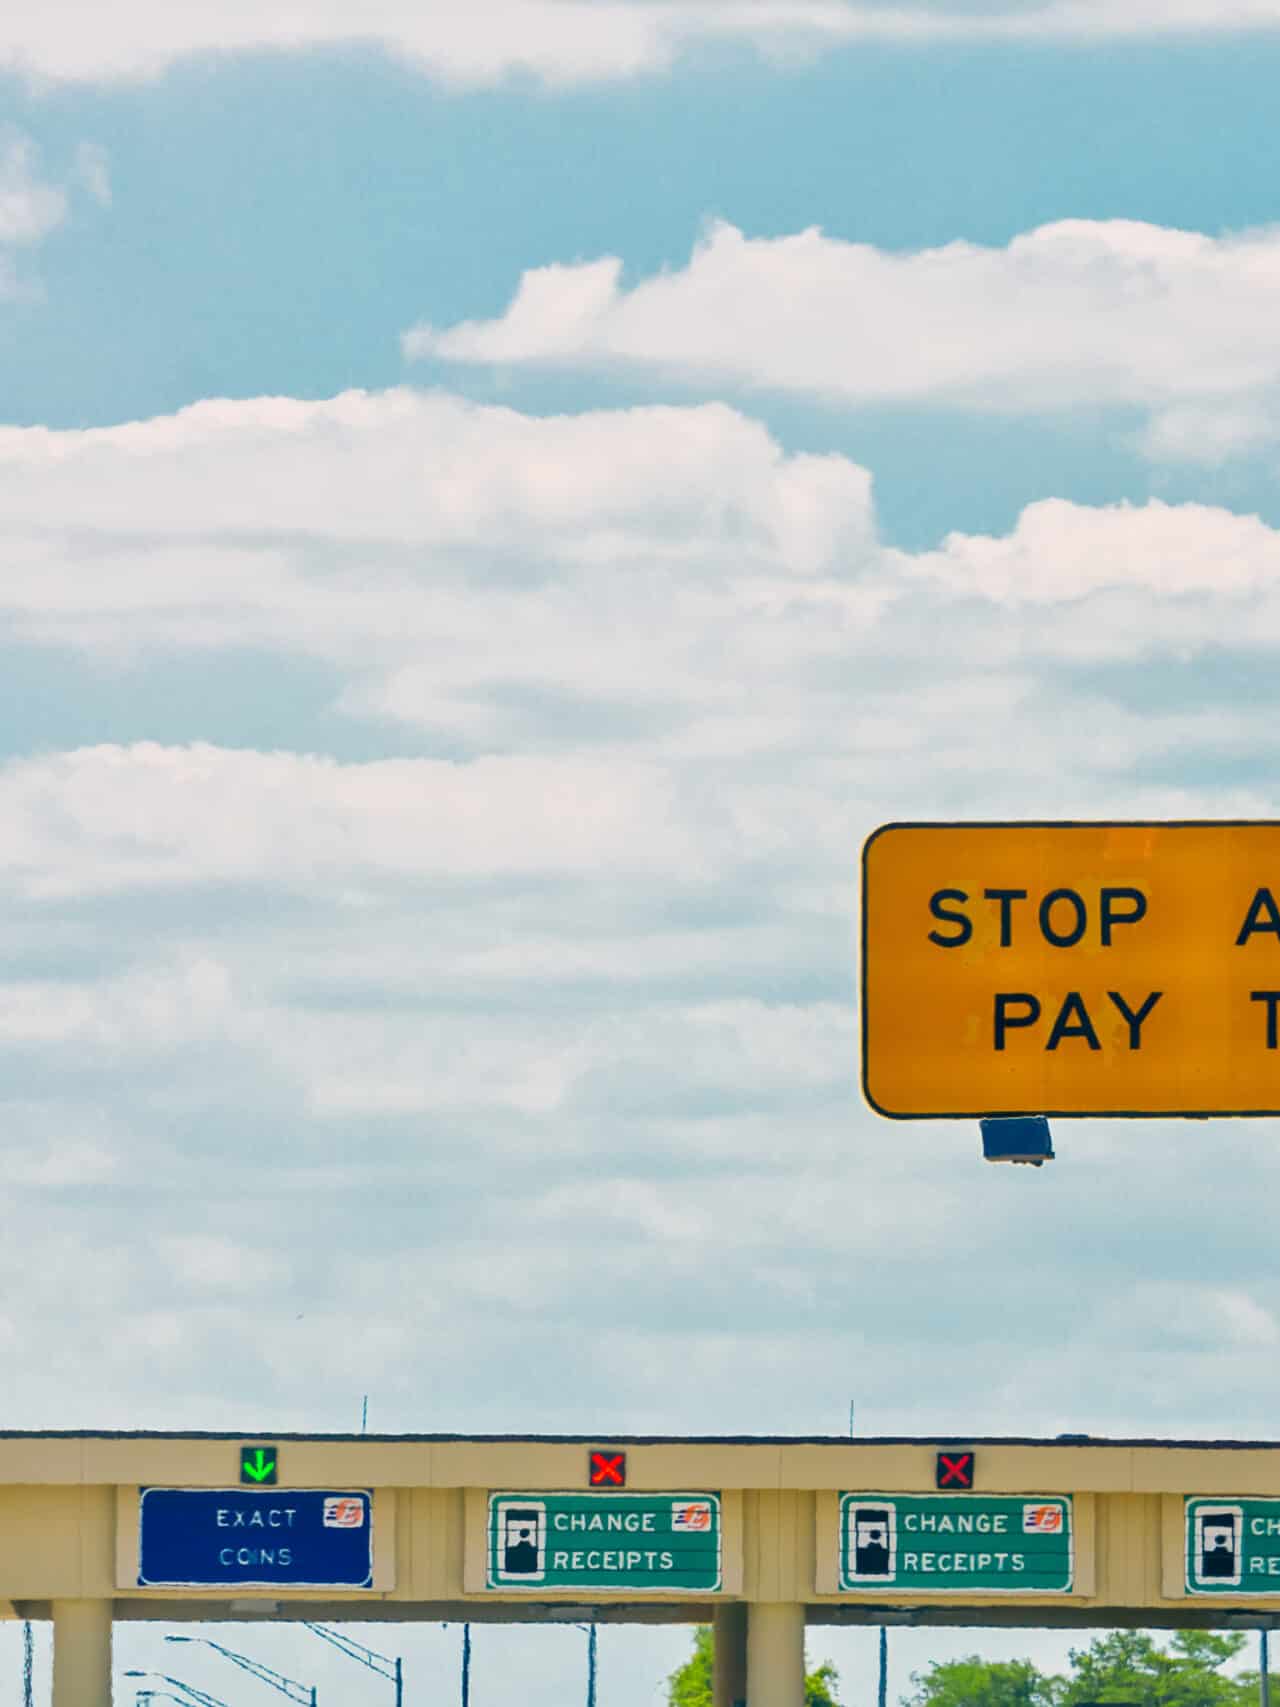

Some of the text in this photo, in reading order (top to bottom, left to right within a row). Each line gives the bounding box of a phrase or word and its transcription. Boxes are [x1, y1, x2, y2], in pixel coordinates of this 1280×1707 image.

[927, 887, 1149, 948] STOP
[993, 990, 1163, 1051] PAY
[216, 1509, 297, 1527] EXACT
[553, 1512, 657, 1532] CHANGE
[904, 1513, 1009, 1533] CHANGE
[219, 1548, 292, 1566] CONS
[553, 1550, 674, 1570] RECEIPTS
[903, 1552, 1026, 1571] RECEIPTS
